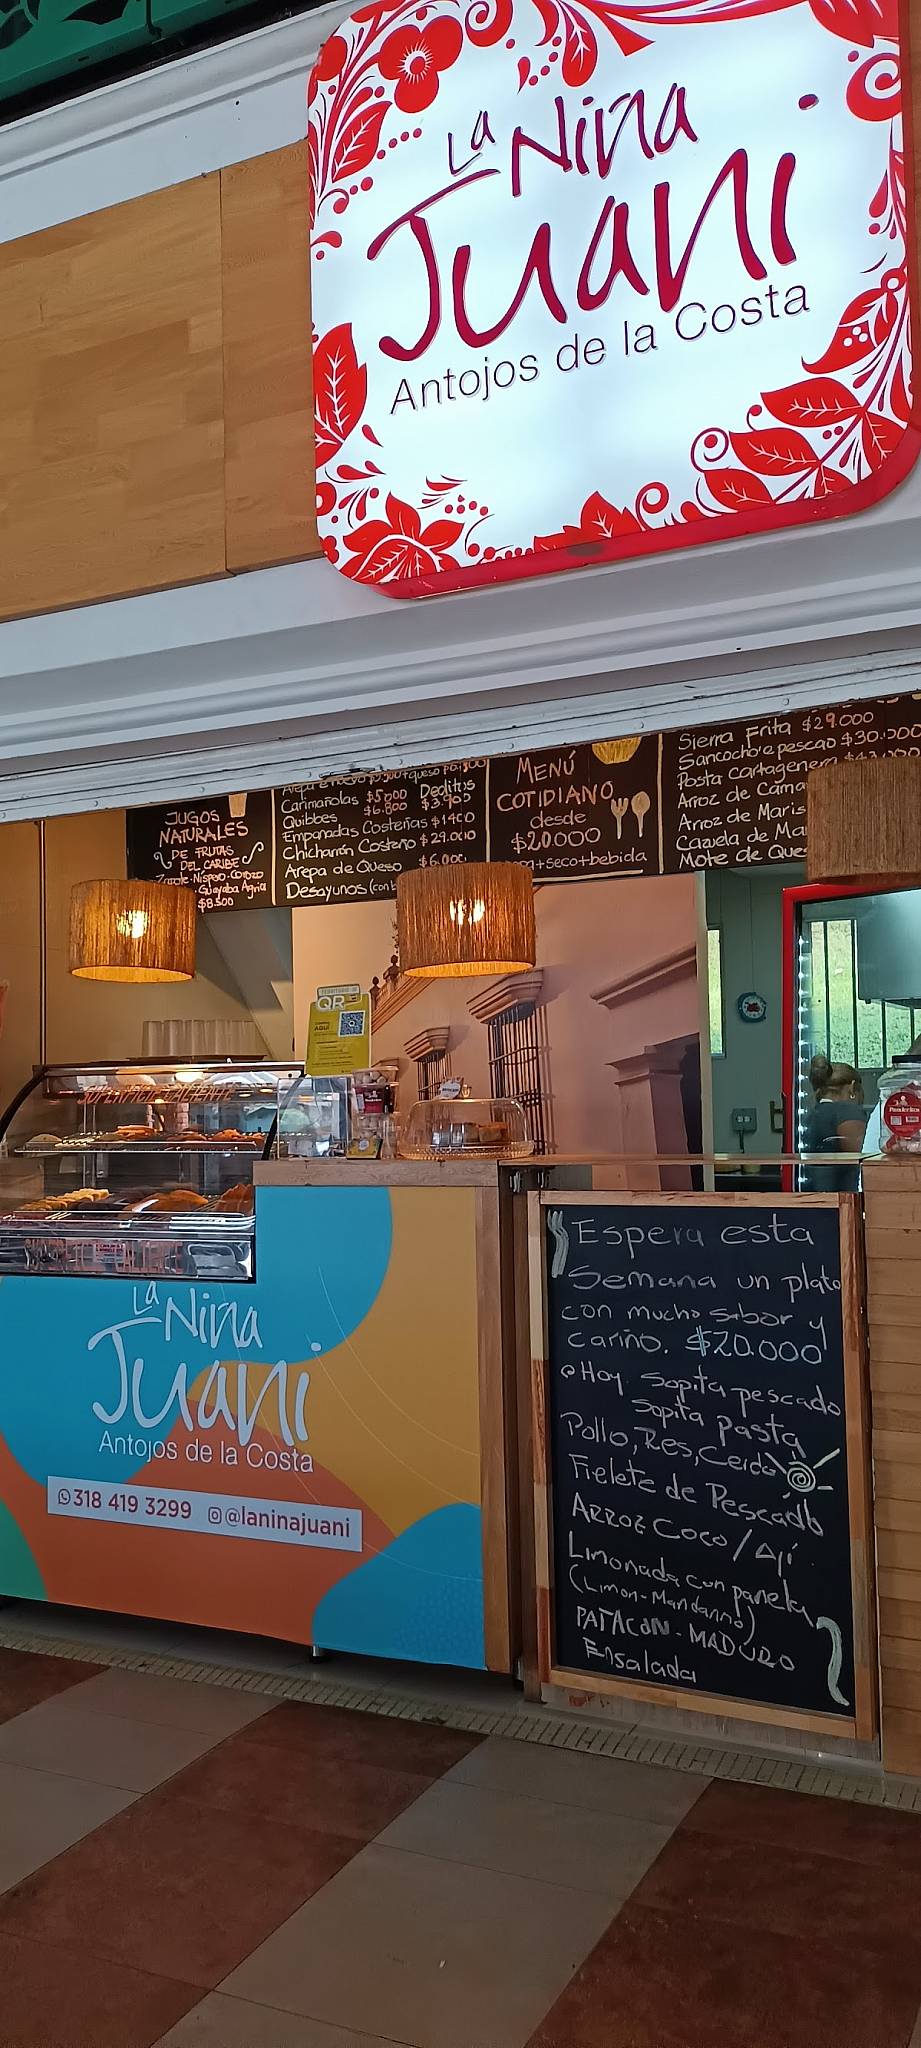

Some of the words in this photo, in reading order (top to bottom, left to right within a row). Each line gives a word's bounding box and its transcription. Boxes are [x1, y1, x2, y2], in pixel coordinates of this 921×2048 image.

[448, 110, 496, 176] La
[366, 93, 820, 362] Juani
[390, 351, 540, 416] Antojos
[556, 333, 606, 374] de
[624, 320, 658, 356] la
[675, 284, 811, 342] Costa
[678, 732, 734, 751] Sierra
[746, 718, 791, 748] Frita
[802, 712, 874, 733] $29.000
[777, 737, 837, 761] pescao
[676, 769, 723, 790] Posta
[281, 790, 360, 814] Carimañolas
[496, 780, 614, 812] COTIDIANO
[677, 792, 721, 809] Arroz
[725, 785, 751, 802] de
[165, 809, 220, 827] JUGOS
[282, 811, 338, 830] Quibbes
[363, 801, 408, 816] $6.800
[530, 809, 587, 829] desde
[678, 813, 722, 831] Arroz
[726, 808, 751, 823] de
[159, 821, 249, 848] NATURALES
[282, 823, 360, 850] Empanadas
[357, 836, 417, 854] Costeño
[510, 827, 601, 855] $20.000
[746, 827, 769, 843] de
[171, 849, 189, 861] DE
[195, 845, 235, 858] FRUTAS
[180, 861, 201, 872] DEL
[203, 857, 240, 870] CARIBE
[679, 851, 729, 870] Mote
[735, 846, 763, 863] de
[284, 863, 328, 884] Arepa
[332, 860, 354, 875] de
[356, 859, 403, 874] Queso
[197, 896, 234, 914] $8.500
[286, 881, 368, 902] Desayunos
[317, 996, 345, 1011] QR
[571, 1218, 704, 1259] Espera
[720, 1213, 815, 1246] esta
[736, 1272, 770, 1290] un
[780, 1262, 841, 1304] plato
[133, 1280, 160, 1316] La
[561, 1303, 612, 1321] con
[627, 1303, 700, 1321] mucho
[808, 1315, 828, 1350] y
[684, 1324, 823, 1365] $20.000
[87, 1316, 322, 1447] Juani
[98, 1430, 178, 1464] Antojos
[185, 1438, 214, 1464] de
[220, 1440, 239, 1466] la
[246, 1443, 314, 1474] Costa
[665, 1473, 697, 1504] de
[73, 1488, 102, 1509] 318
[108, 1494, 139, 1513] 419
[144, 1497, 192, 1520] 3299
[224, 1505, 352, 1538] @laninajuani
[568, 1530, 681, 1589] Limonada
[686, 1573, 726, 1593] con
[582, 1637, 697, 1684] Ensalada
